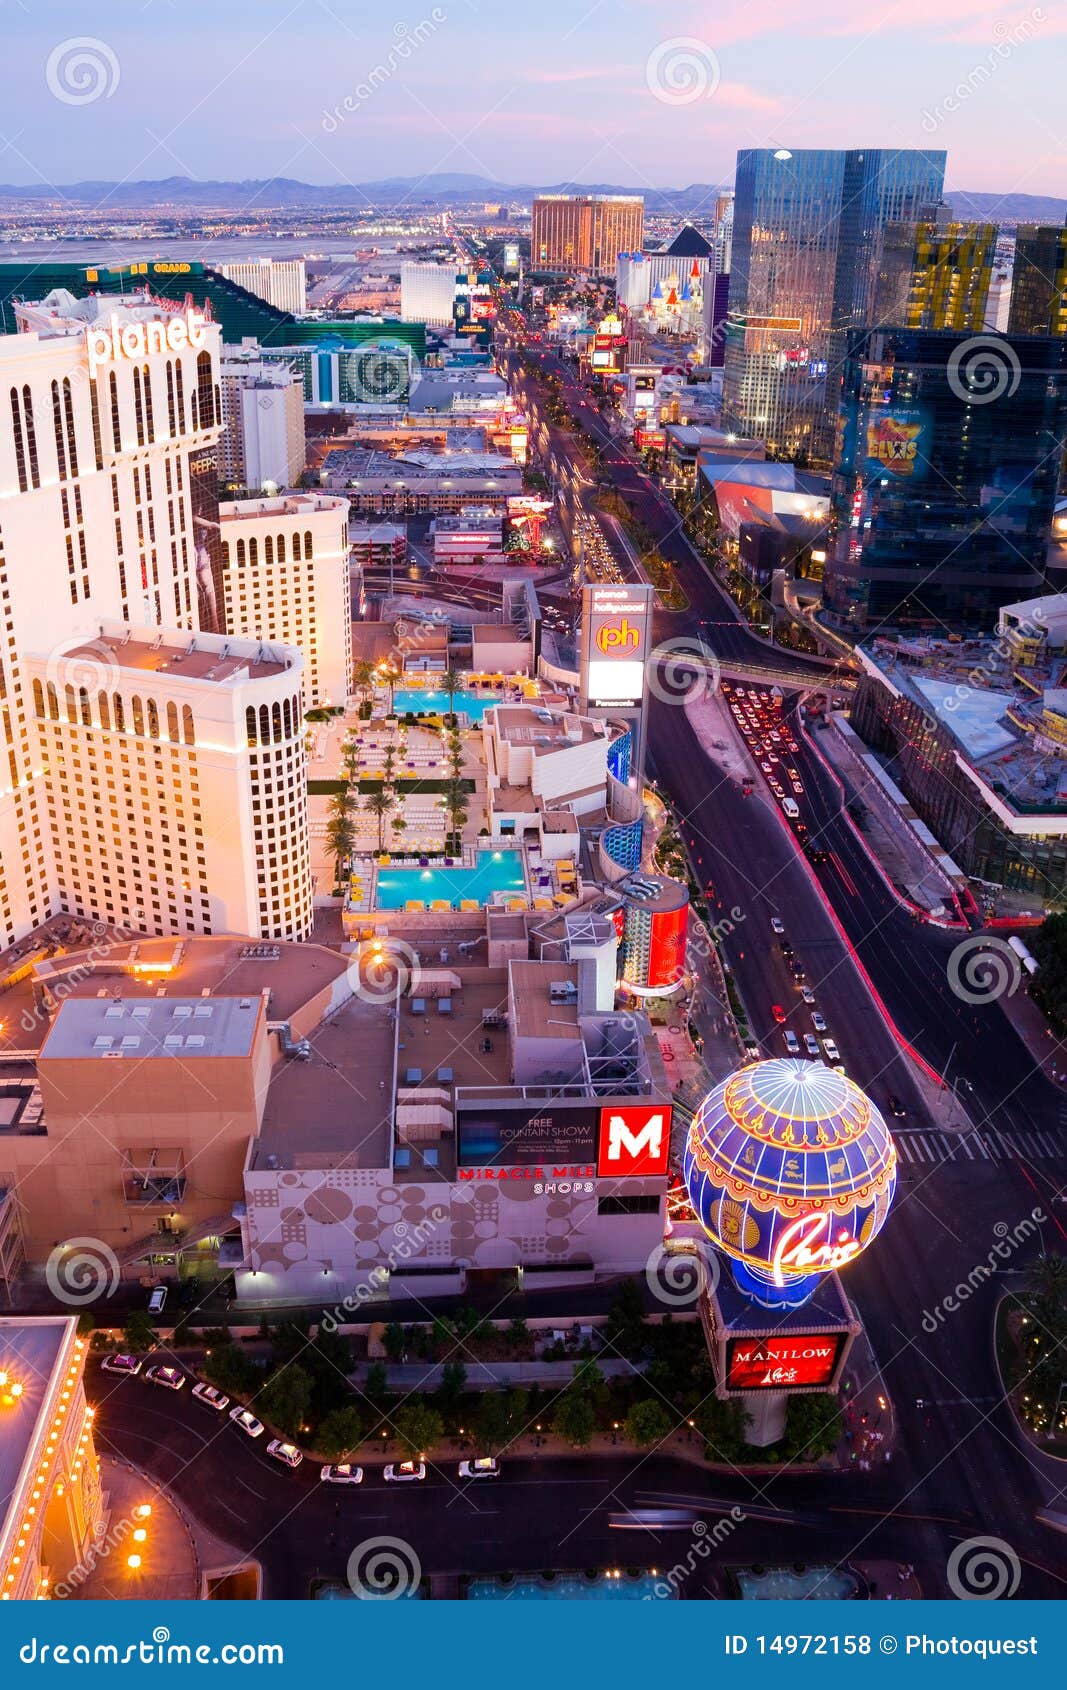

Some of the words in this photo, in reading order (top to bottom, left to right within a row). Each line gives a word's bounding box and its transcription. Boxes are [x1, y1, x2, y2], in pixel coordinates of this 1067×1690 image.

[455, 284, 491, 296] MGM
[87, 308, 207, 380] planet
[868, 439, 918, 460] ELVIS
[595, 589, 629, 601] planet
[594, 603, 645, 614] hollywood
[601, 618, 639, 653] ph
[528, 1118, 553, 1128] FREE
[500, 1127, 550, 1138] FOUNTAIN
[552, 1126, 592, 1137] SHOW
[608, 1114, 664, 1161] M
[533, 1182, 594, 1195] SHOPS
[773, 1211, 860, 1288] Paris
[736, 1347, 832, 1362] MANILOW
